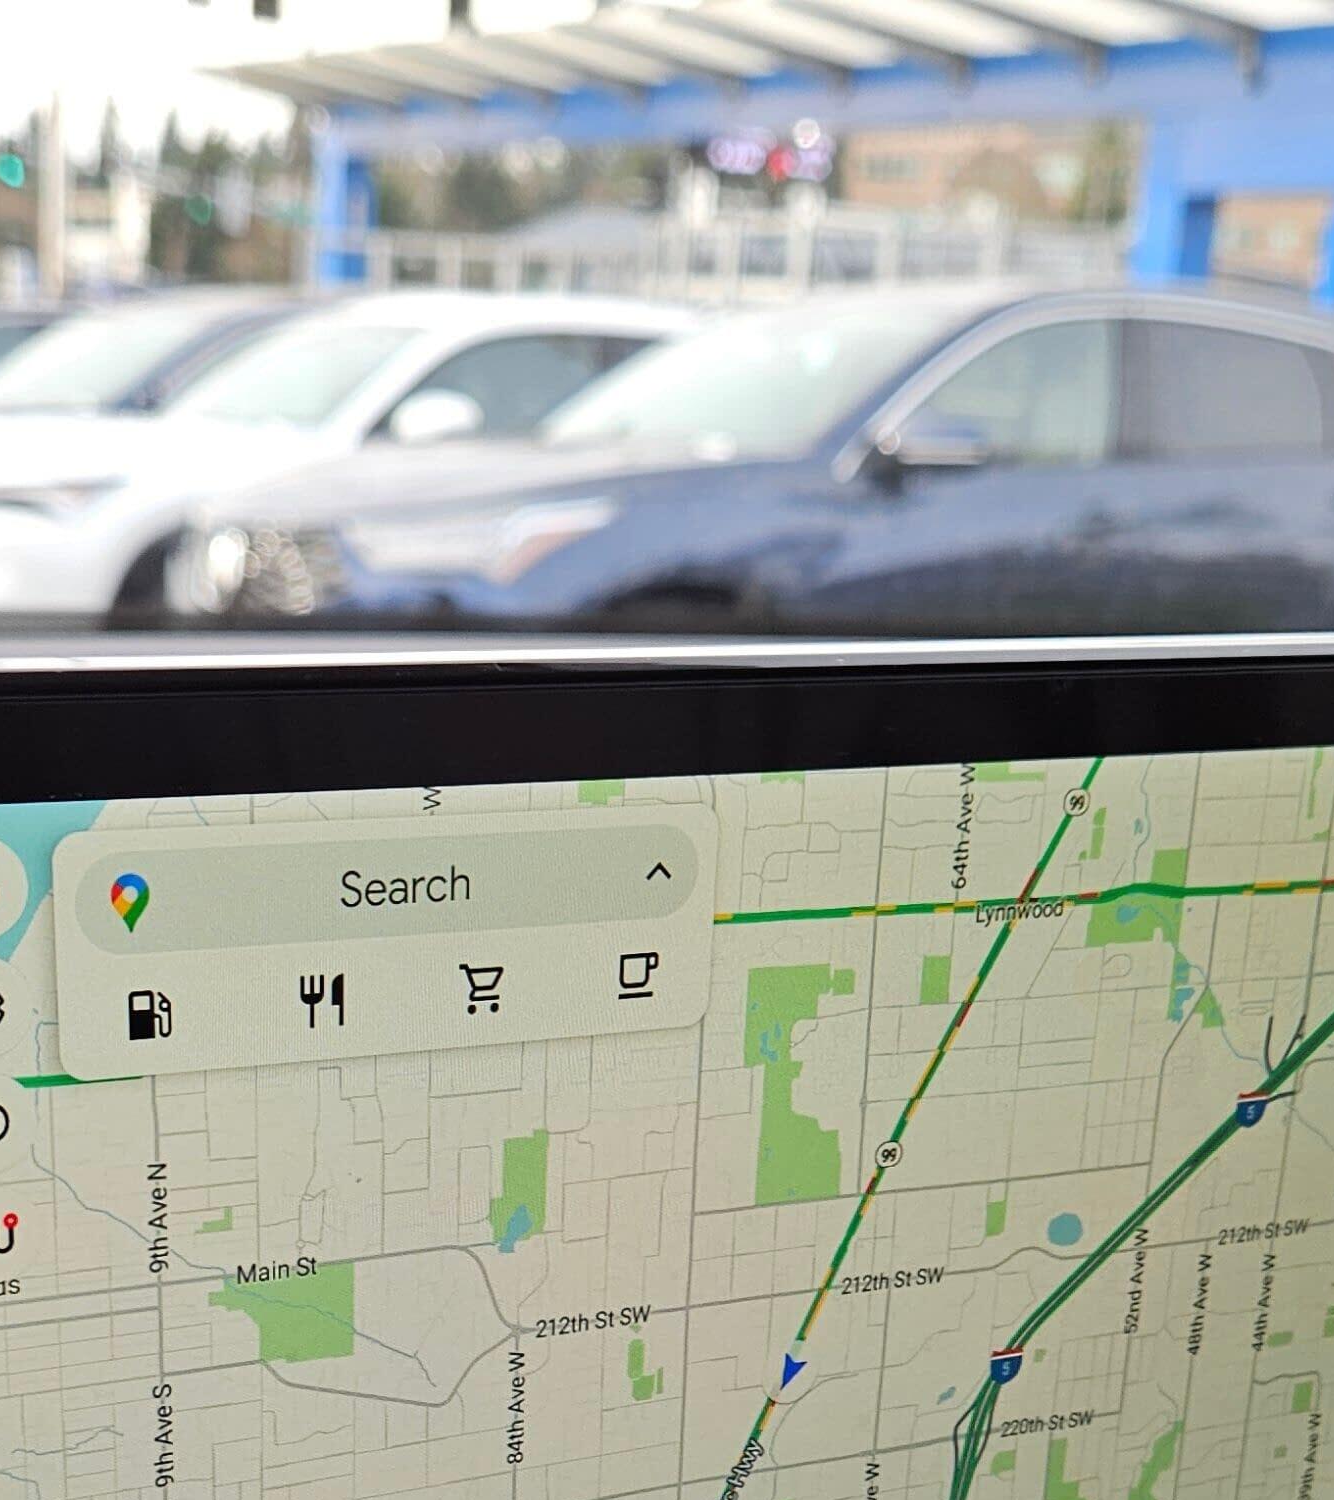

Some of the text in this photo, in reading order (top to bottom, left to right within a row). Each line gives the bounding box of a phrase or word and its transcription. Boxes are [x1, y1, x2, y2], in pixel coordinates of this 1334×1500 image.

[951, 763, 975, 889] 64th Ave W
[341, 865, 470, 908] Search
[976, 902, 1063, 927] Lynnwood
[882, 1147, 897, 1162] 99
[148, 1163, 169, 1272] 9th Ave N
[1218, 1218, 1309, 1246] 212th St SW
[236, 1256, 317, 1285] Main St
[841, 1267, 944, 1294] 212th St SW
[1124, 1228, 1149, 1334] 52nd Ave W
[535, 1305, 650, 1338] 212th St SW
[1187, 1254, 1213, 1355] 48th Ave W
[1251, 1254, 1276, 1351] 44th Ave W
[506, 1352, 525, 1464] 84th Ave W
[1000, 1410, 1094, 1438] 220th St SW
[152, 1383, 174, 1488] 9th Ave S
[726, 1439, 765, 1488] Hwy
[865, 1462, 880, 1481] W
